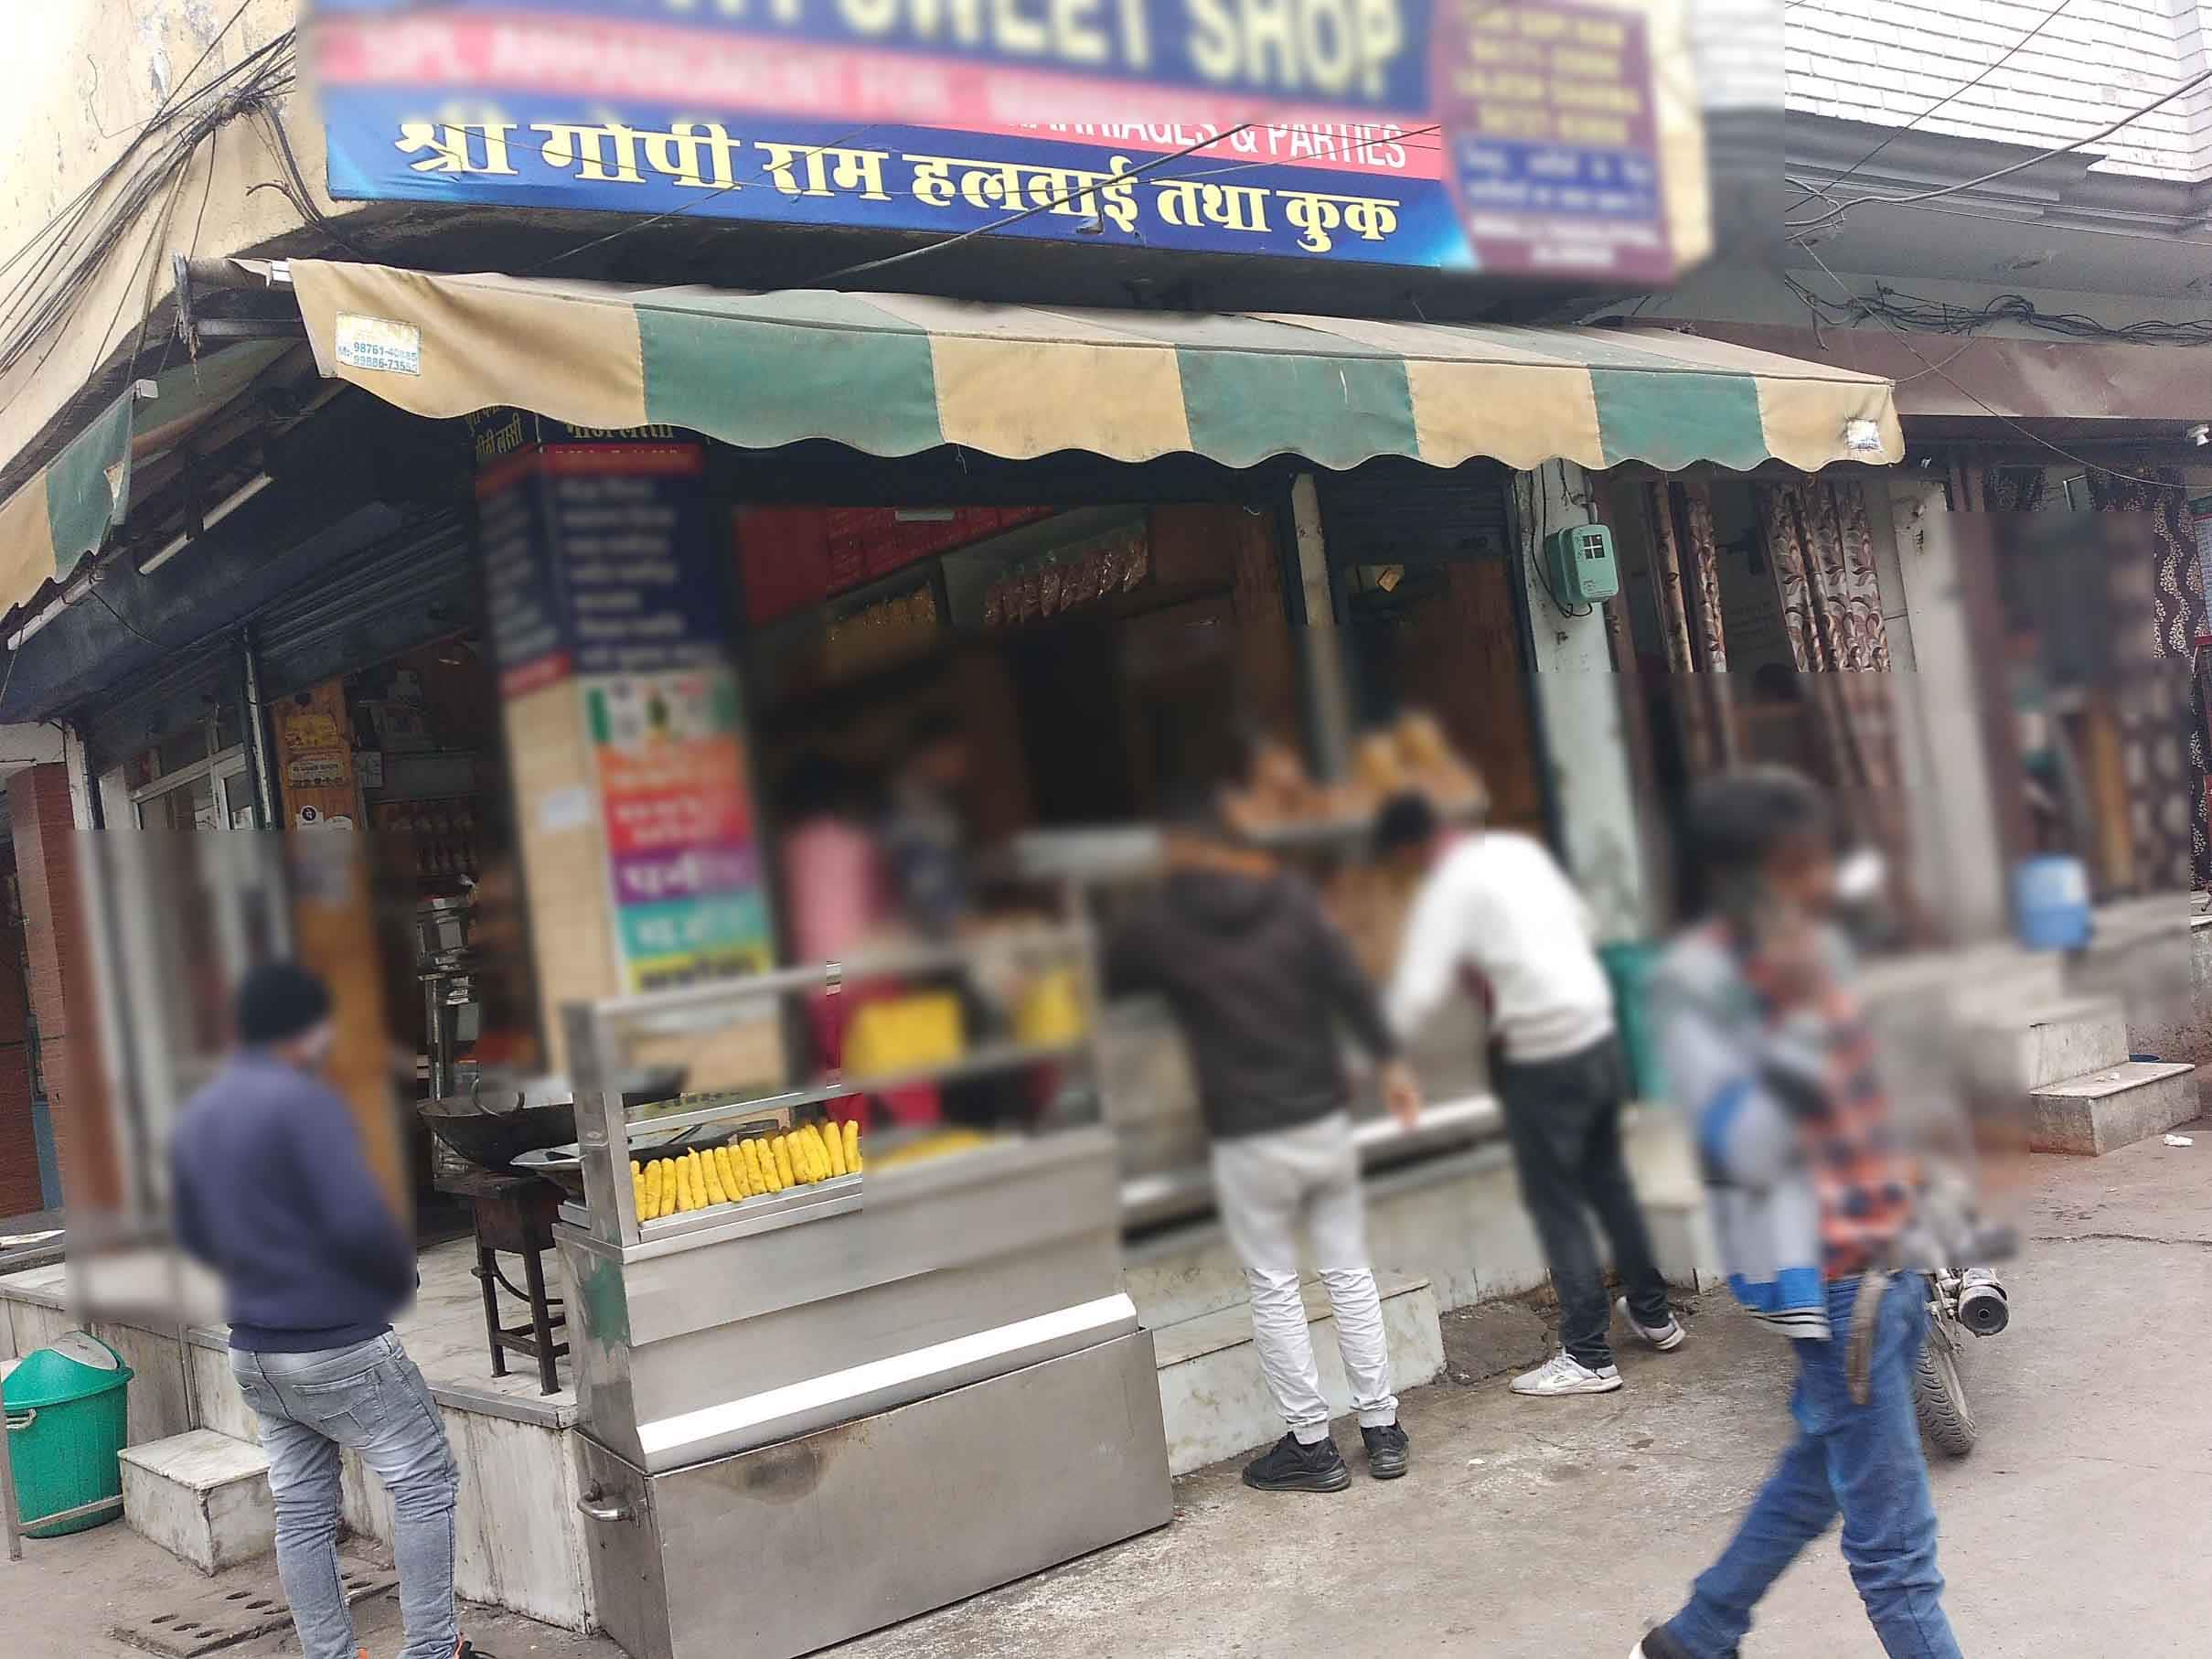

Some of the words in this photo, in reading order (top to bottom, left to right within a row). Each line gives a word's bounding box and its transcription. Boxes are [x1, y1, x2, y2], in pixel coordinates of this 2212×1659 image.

[395, 101, 518, 177] श्री
[530, 102, 743, 191] गोपी
[754, 142, 892, 202] राम
[903, 155, 1140, 234] हलवाई
[1150, 179, 1272, 232] तथा
[1277, 190, 1401, 253] कुक
[1267, 120, 1406, 169] PARTIES
